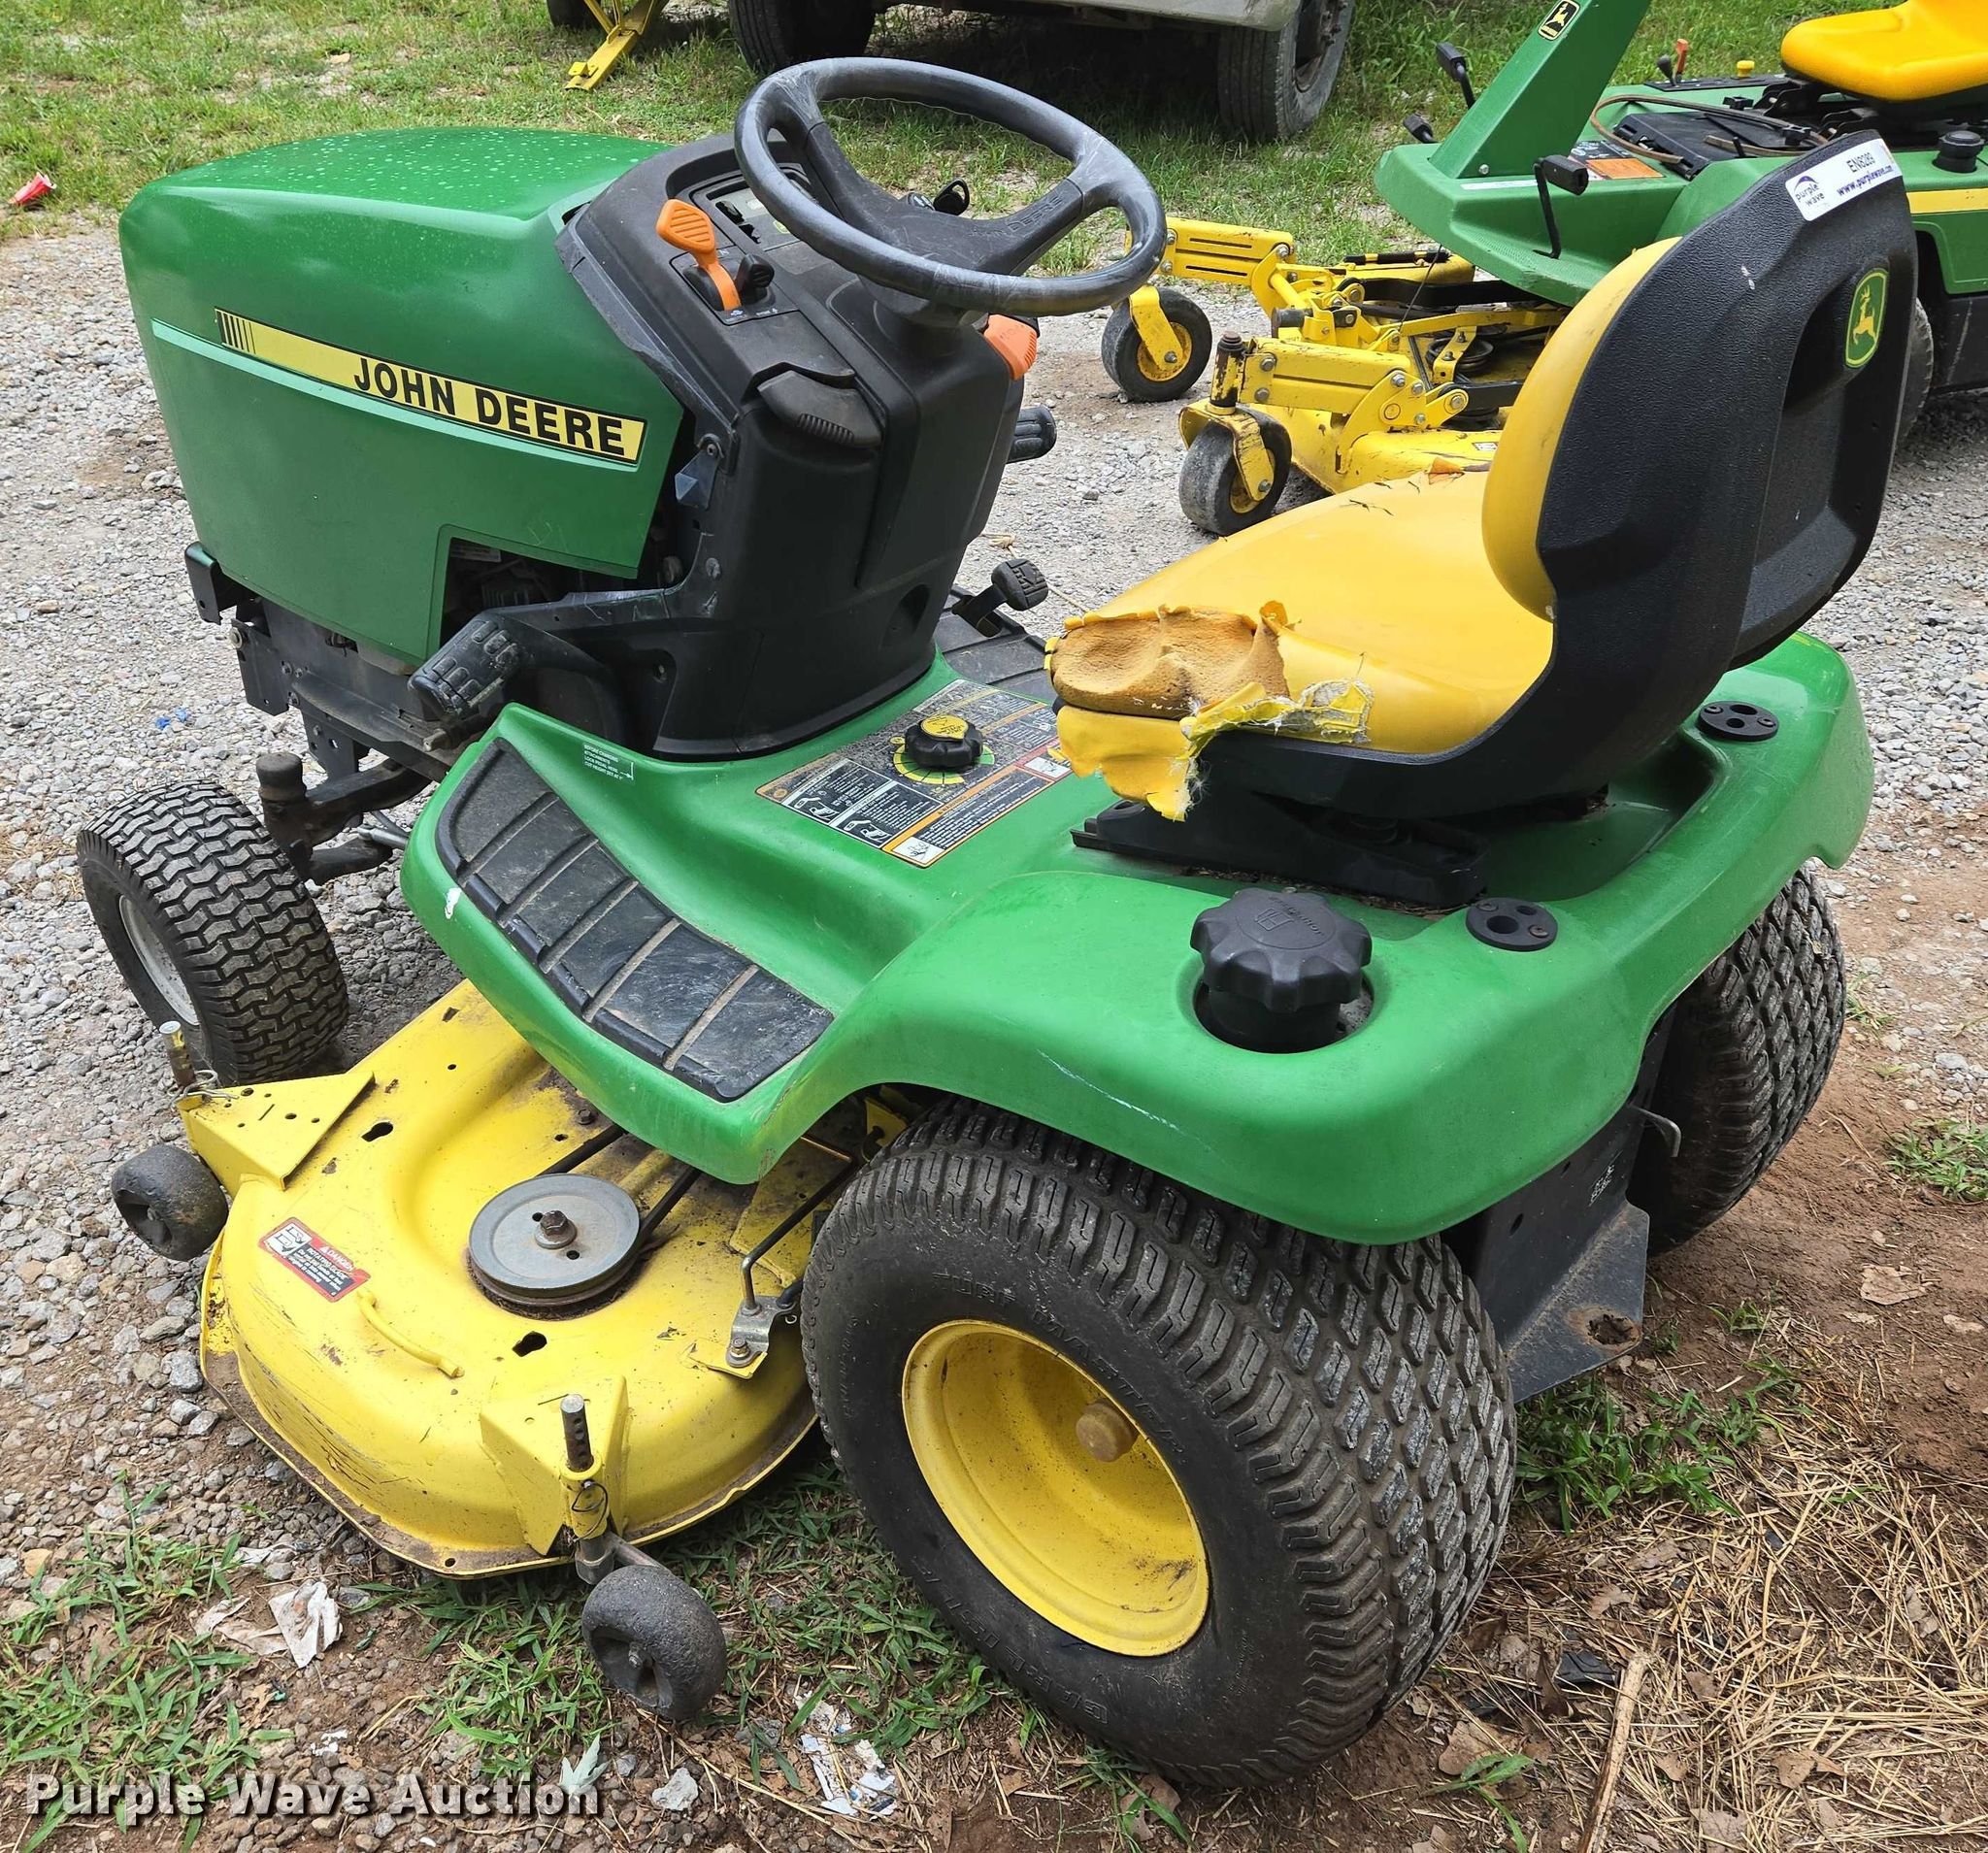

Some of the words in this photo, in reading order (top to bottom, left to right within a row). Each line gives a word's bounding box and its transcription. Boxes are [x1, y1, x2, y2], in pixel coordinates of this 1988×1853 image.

[1795, 183, 1820, 202] purple
[1806, 192, 1825, 207] wave
[354, 357, 455, 415] JOHN
[475, 387, 624, 456] DEERE
